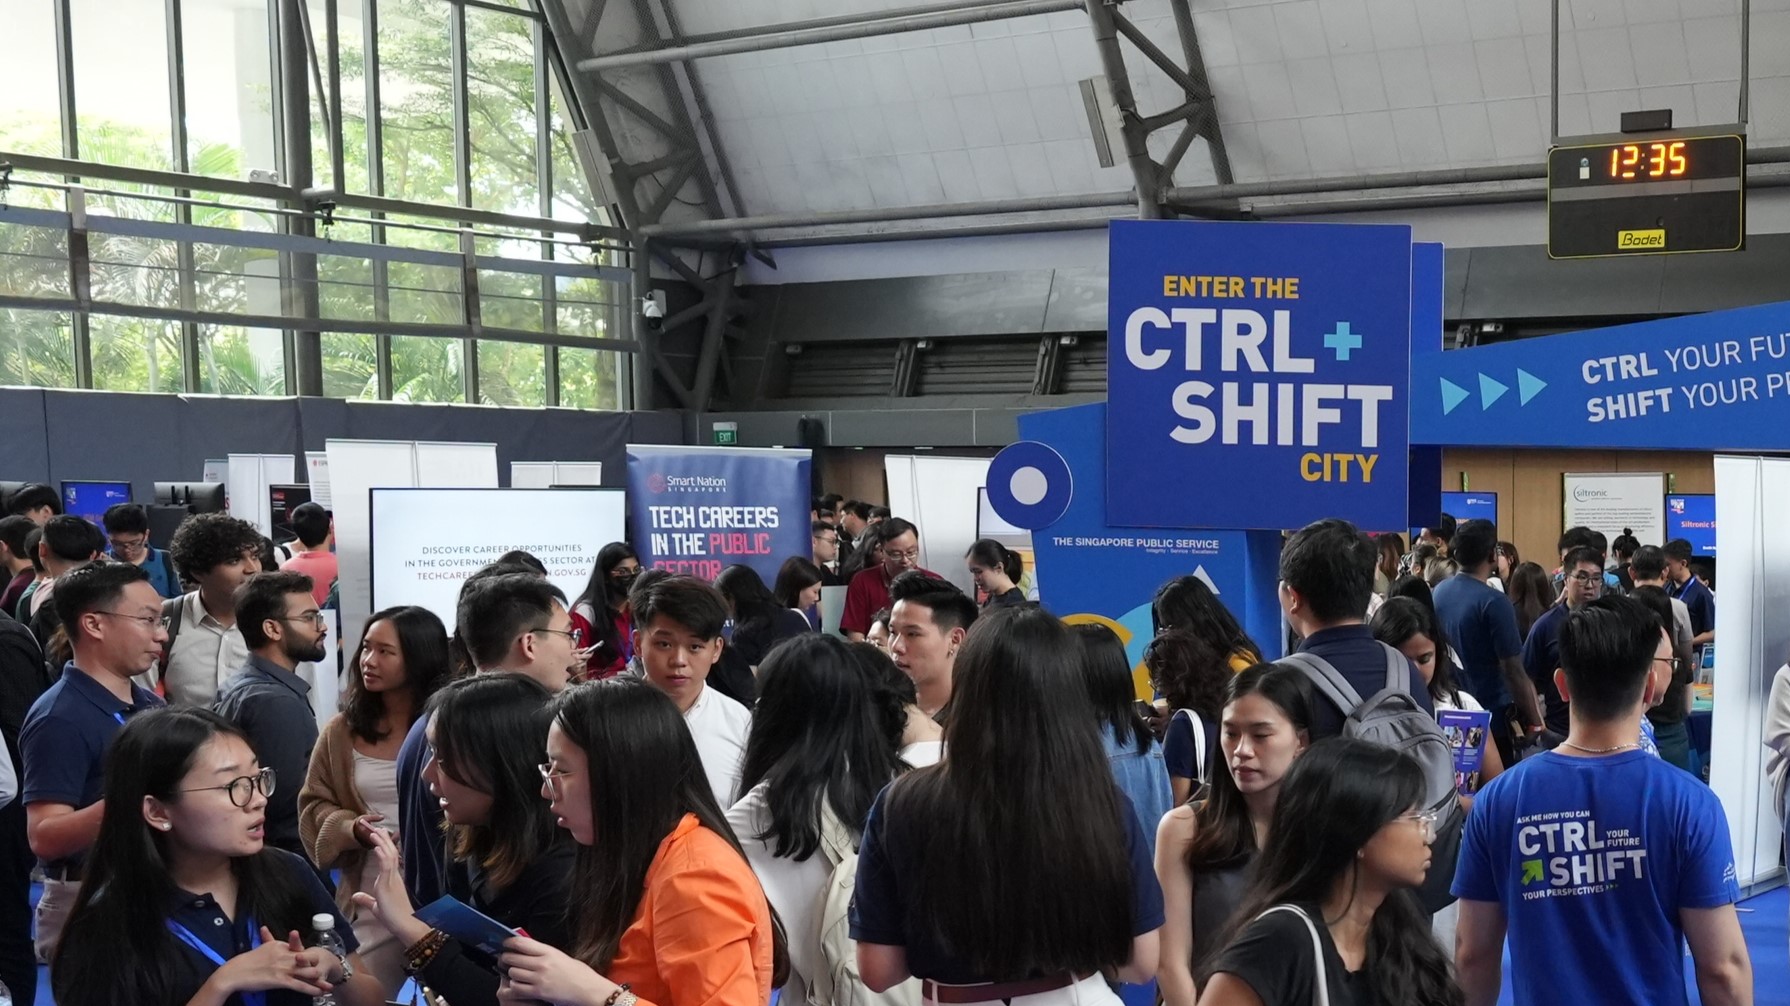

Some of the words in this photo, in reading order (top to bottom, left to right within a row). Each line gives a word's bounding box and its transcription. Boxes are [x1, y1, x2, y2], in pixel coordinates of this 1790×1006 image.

[1611, 142, 1686, 178] 12:35
[1621, 232, 1663, 246] Bodet
[1163, 275, 1245, 298] ENTER
[1250, 277, 1300, 299] THE
[1581, 352, 1659, 385] CTRL
[1664, 339, 1742, 374] YOUR
[1586, 387, 1673, 423] SHIFT
[1680, 376, 1759, 409] YOUR
[1169, 380, 1393, 448] SHIFT
[1300, 453, 1379, 483] CITY
[667, 475, 696, 486] Smart
[696, 476, 726, 487] Nation
[1576, 489, 1608, 497] siltronic
[649, 506, 696, 529] TECH
[699, 506, 779, 529] CAREERS
[422, 545, 471, 555] DISCOVER
[473, 545, 509, 553] CAREER
[511, 544, 583, 553] OPPORTUNITIES
[651, 533, 669, 555] IN
[672, 533, 707, 555] THE
[709, 533, 771, 555] PUBLIC
[1053, 537, 1073, 546] THE
[1075, 537, 1134, 547] SINGAPORE
[1136, 538, 1174, 548] PUBLIC
[1176, 539, 1219, 549] SERVICE
[404, 560, 416, 568] IN
[438, 558, 498, 567] GOVERNMEN
[550, 556, 581, 565] SECTOR
[582, 556, 595, 564] AT
[1517, 816, 1531, 824] ASK
[1531, 814, 1542, 822] ME
[1543, 812, 1559, 821] HOW
[1560, 811, 1575, 819] YOU
[1576, 810, 1590, 818] CAN
[1518, 820, 1604, 856] CTRL
[1606, 829, 1629, 839] YOUR
[1607, 837, 1640, 848] FUTURE
[1549, 849, 1647, 887] SHIFT
[1522, 889, 1545, 900] YOUR
[1546, 885, 1605, 897] PERSPECTIVES
